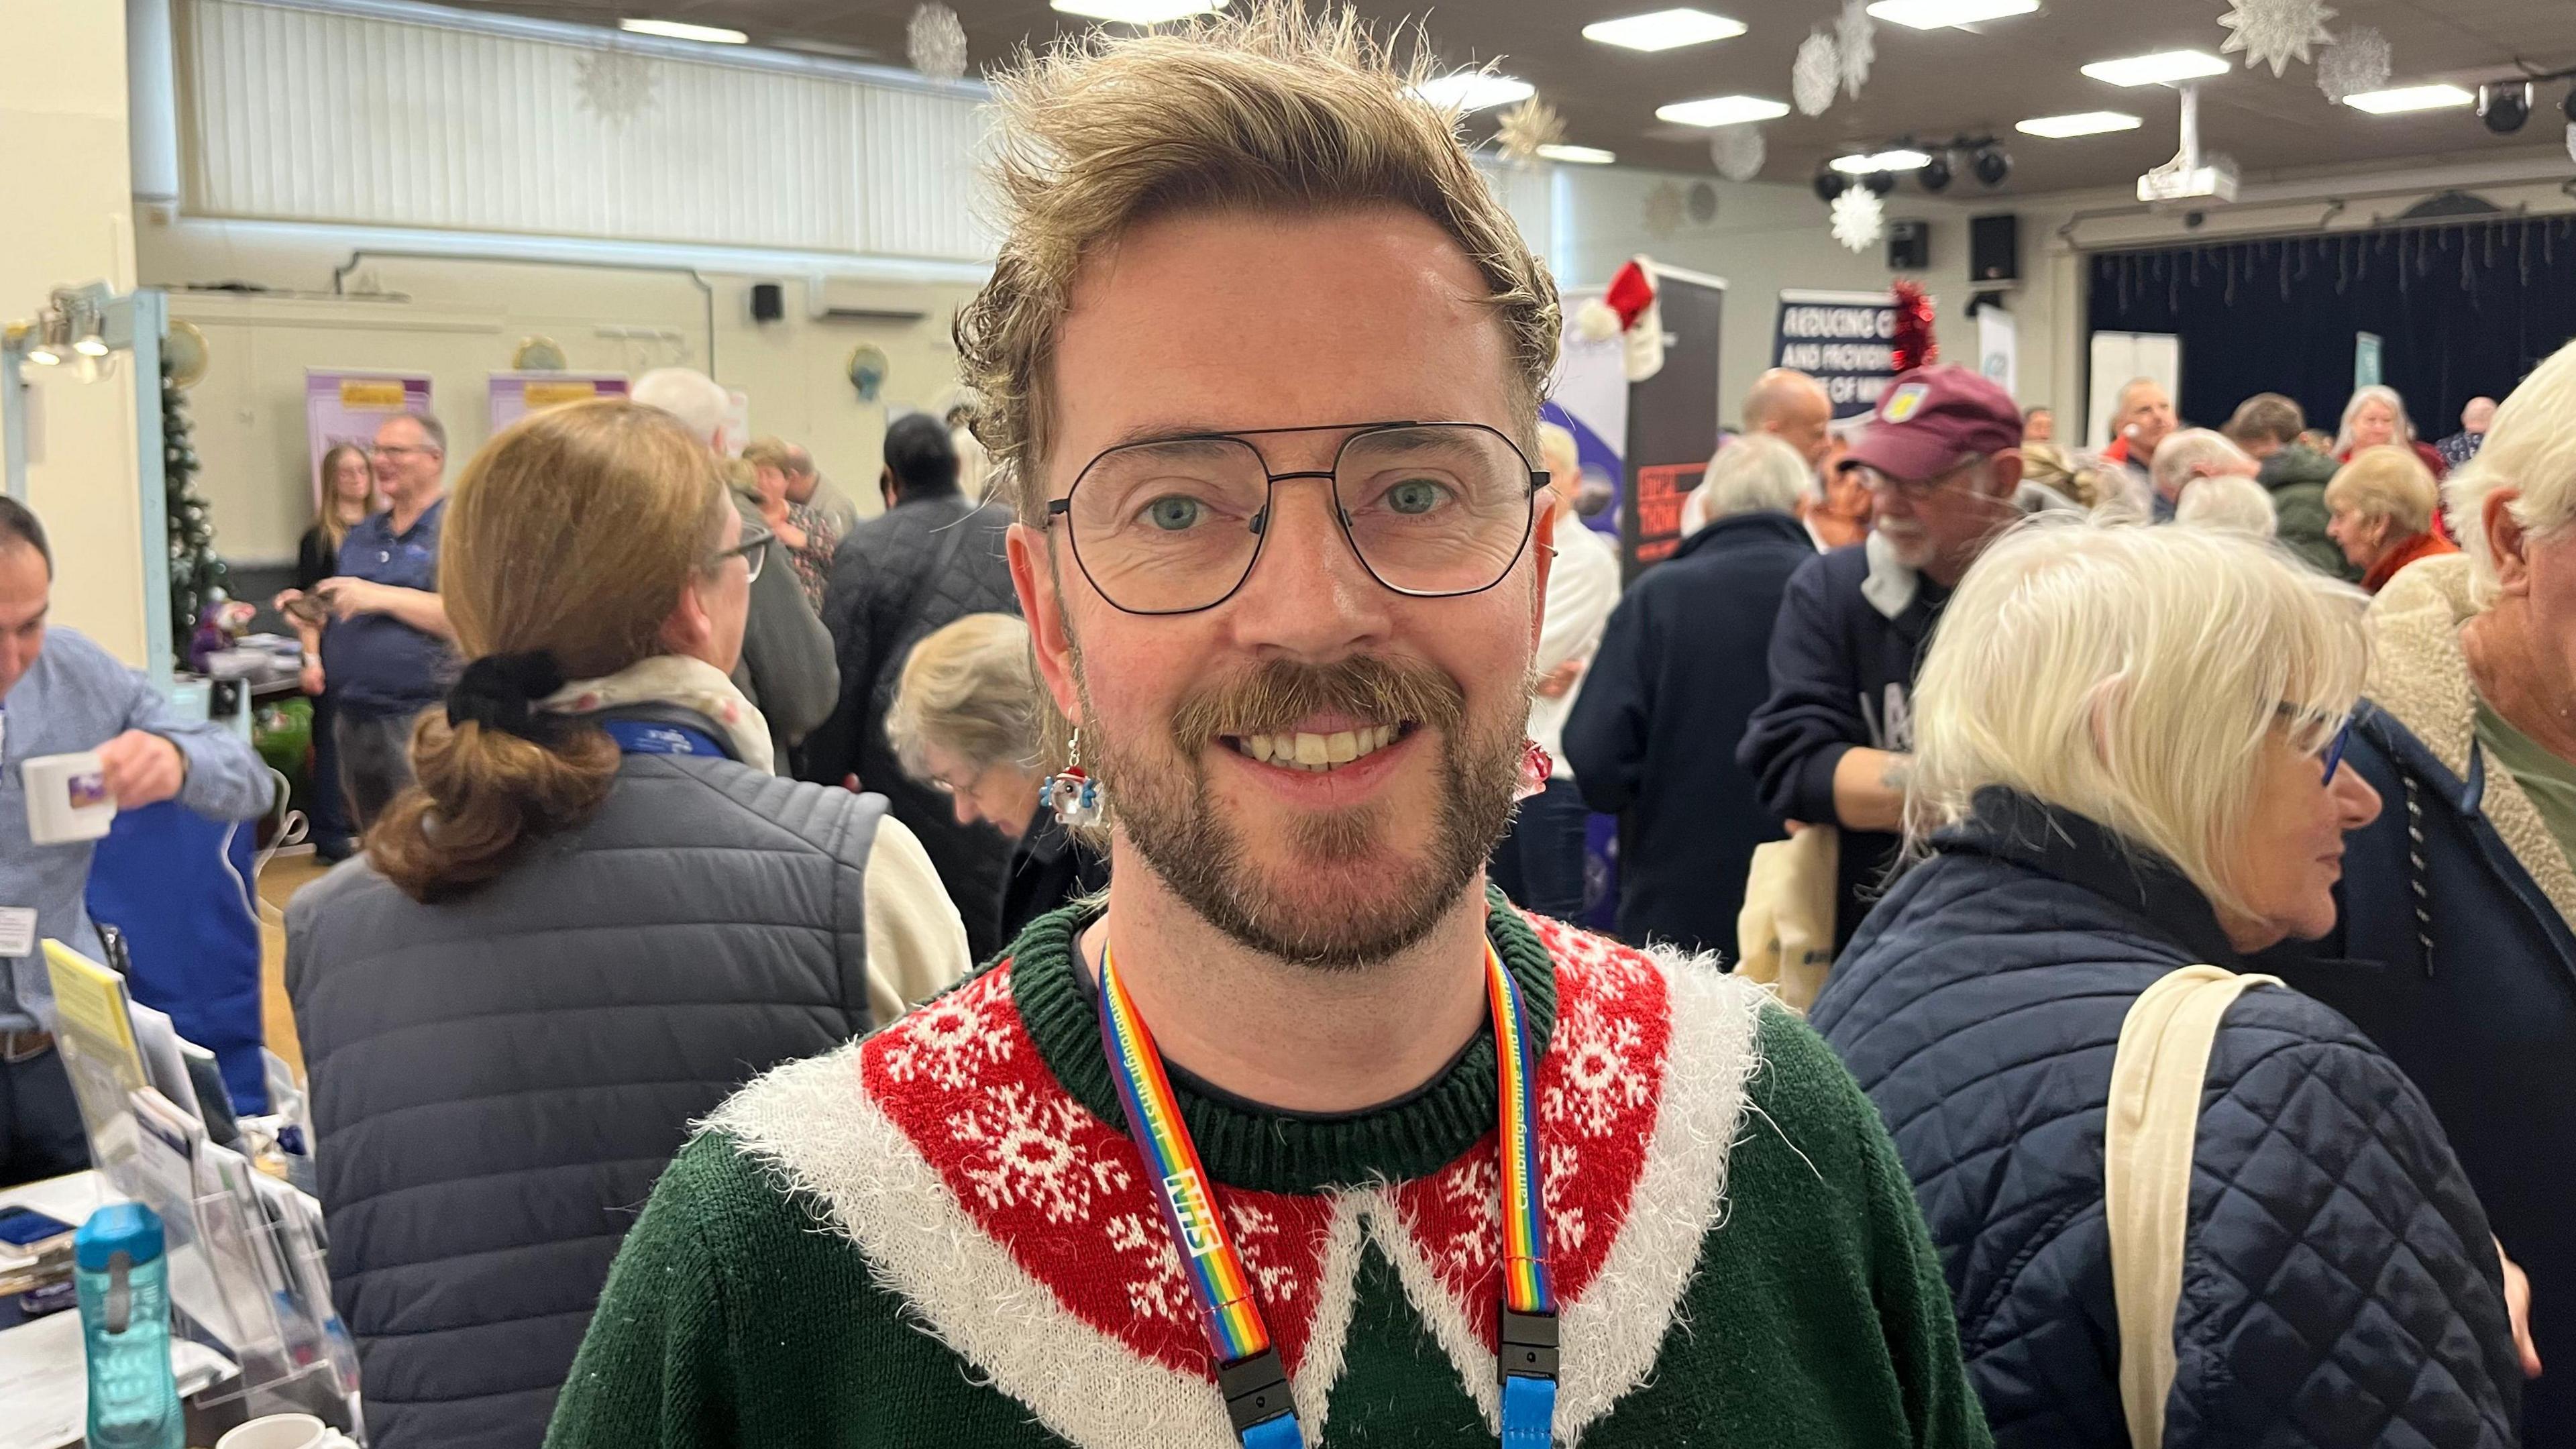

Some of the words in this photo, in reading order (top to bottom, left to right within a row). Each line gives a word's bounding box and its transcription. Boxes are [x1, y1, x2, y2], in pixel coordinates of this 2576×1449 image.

[1782, 307, 1876, 339] REDUCING
[1781, 343, 1821, 371] AND
[1509, 1033, 1523, 1065] and
[1135, 1077, 1159, 1117] NHS
[1150, 1118, 1168, 1140] FT
[1513, 1071, 1528, 1210] Cambridgeshire
[1166, 1174, 1220, 1250] NHS
